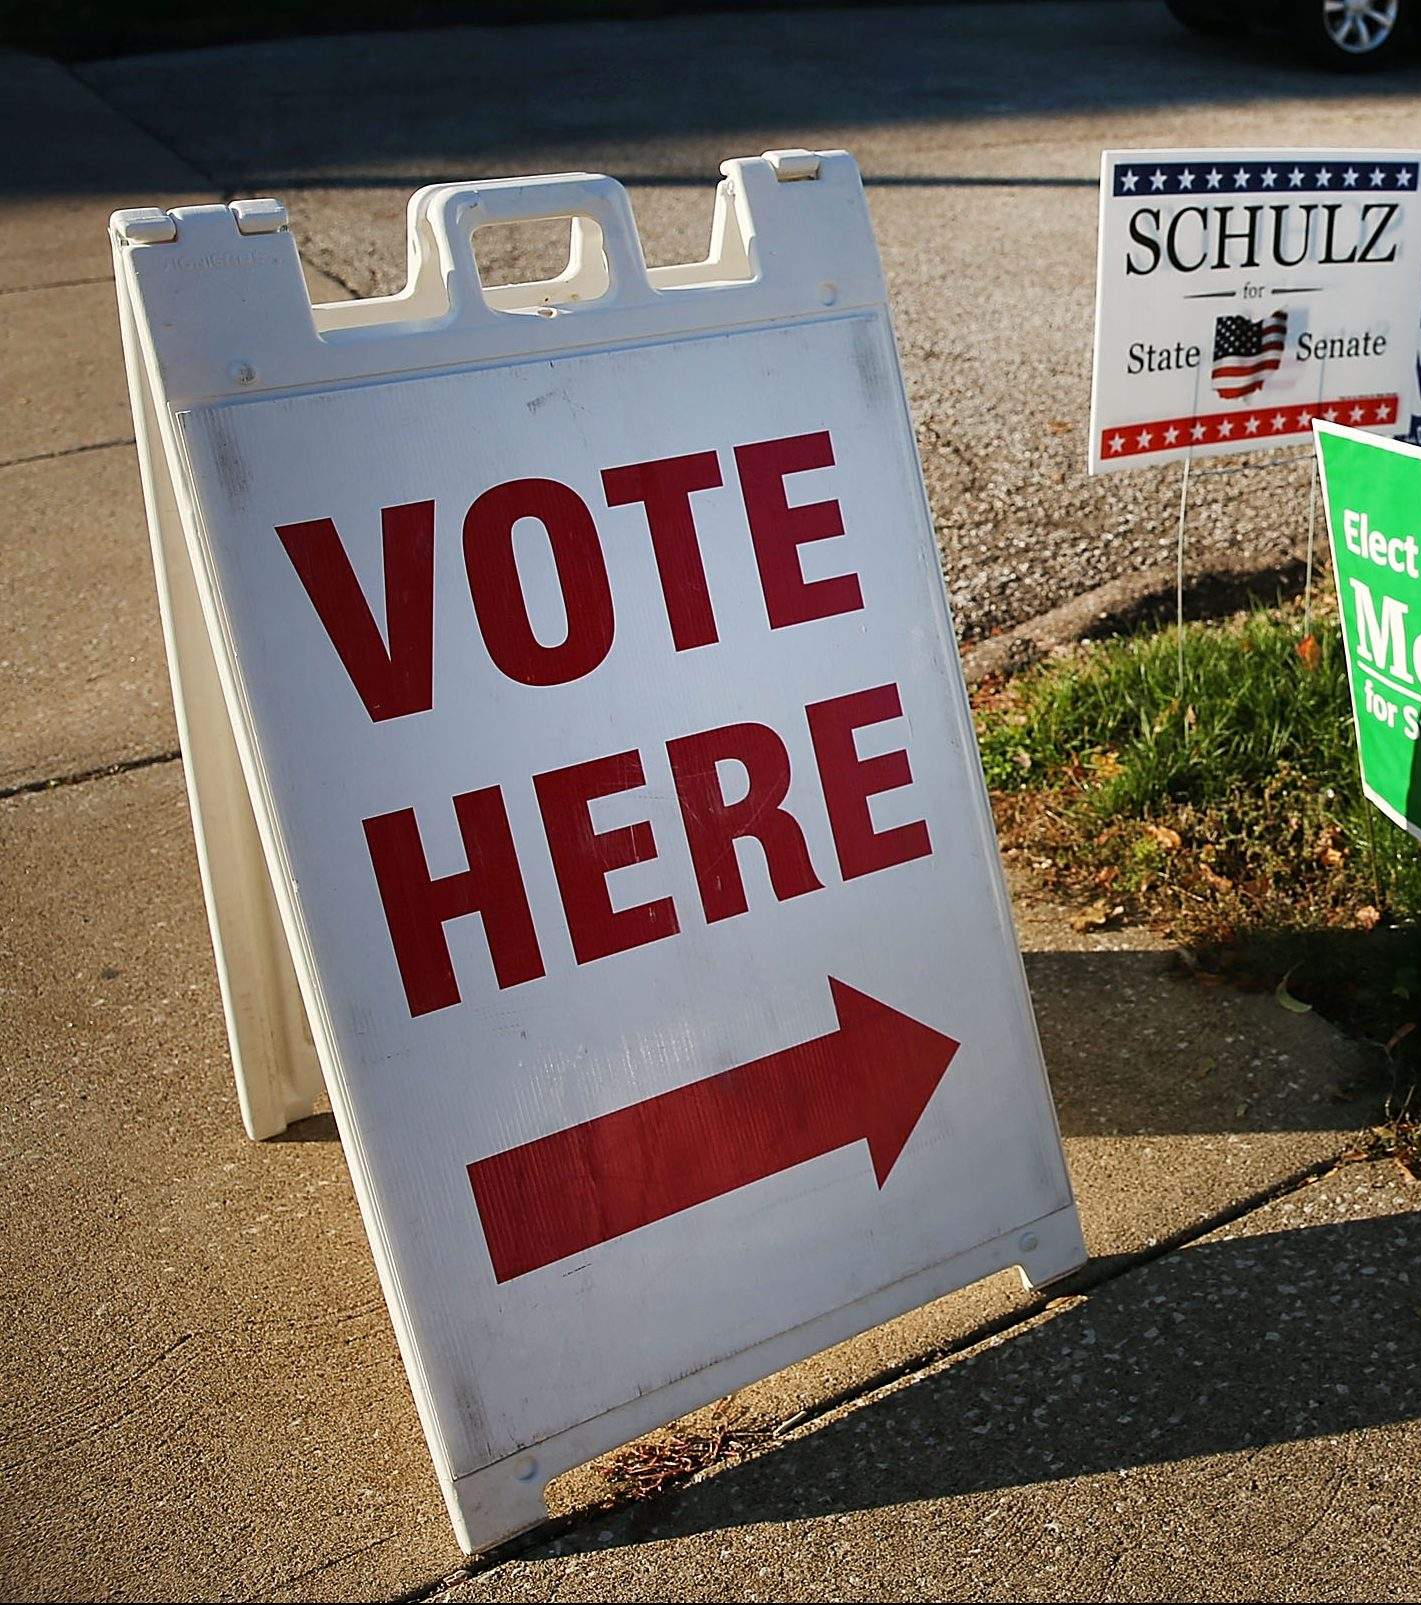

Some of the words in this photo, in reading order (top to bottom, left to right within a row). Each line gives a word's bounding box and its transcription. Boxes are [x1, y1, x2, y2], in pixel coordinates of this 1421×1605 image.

[1125, 202, 1400, 276] SCHULZ
[1243, 281, 1266, 299] for
[1127, 342, 1202, 375] State
[1295, 331, 1387, 362] Senate
[275, 431, 865, 723] VOTE
[1343, 507, 1420, 579] Elect
[1364, 679, 1399, 729] for
[362, 682, 934, 1018] HERE
